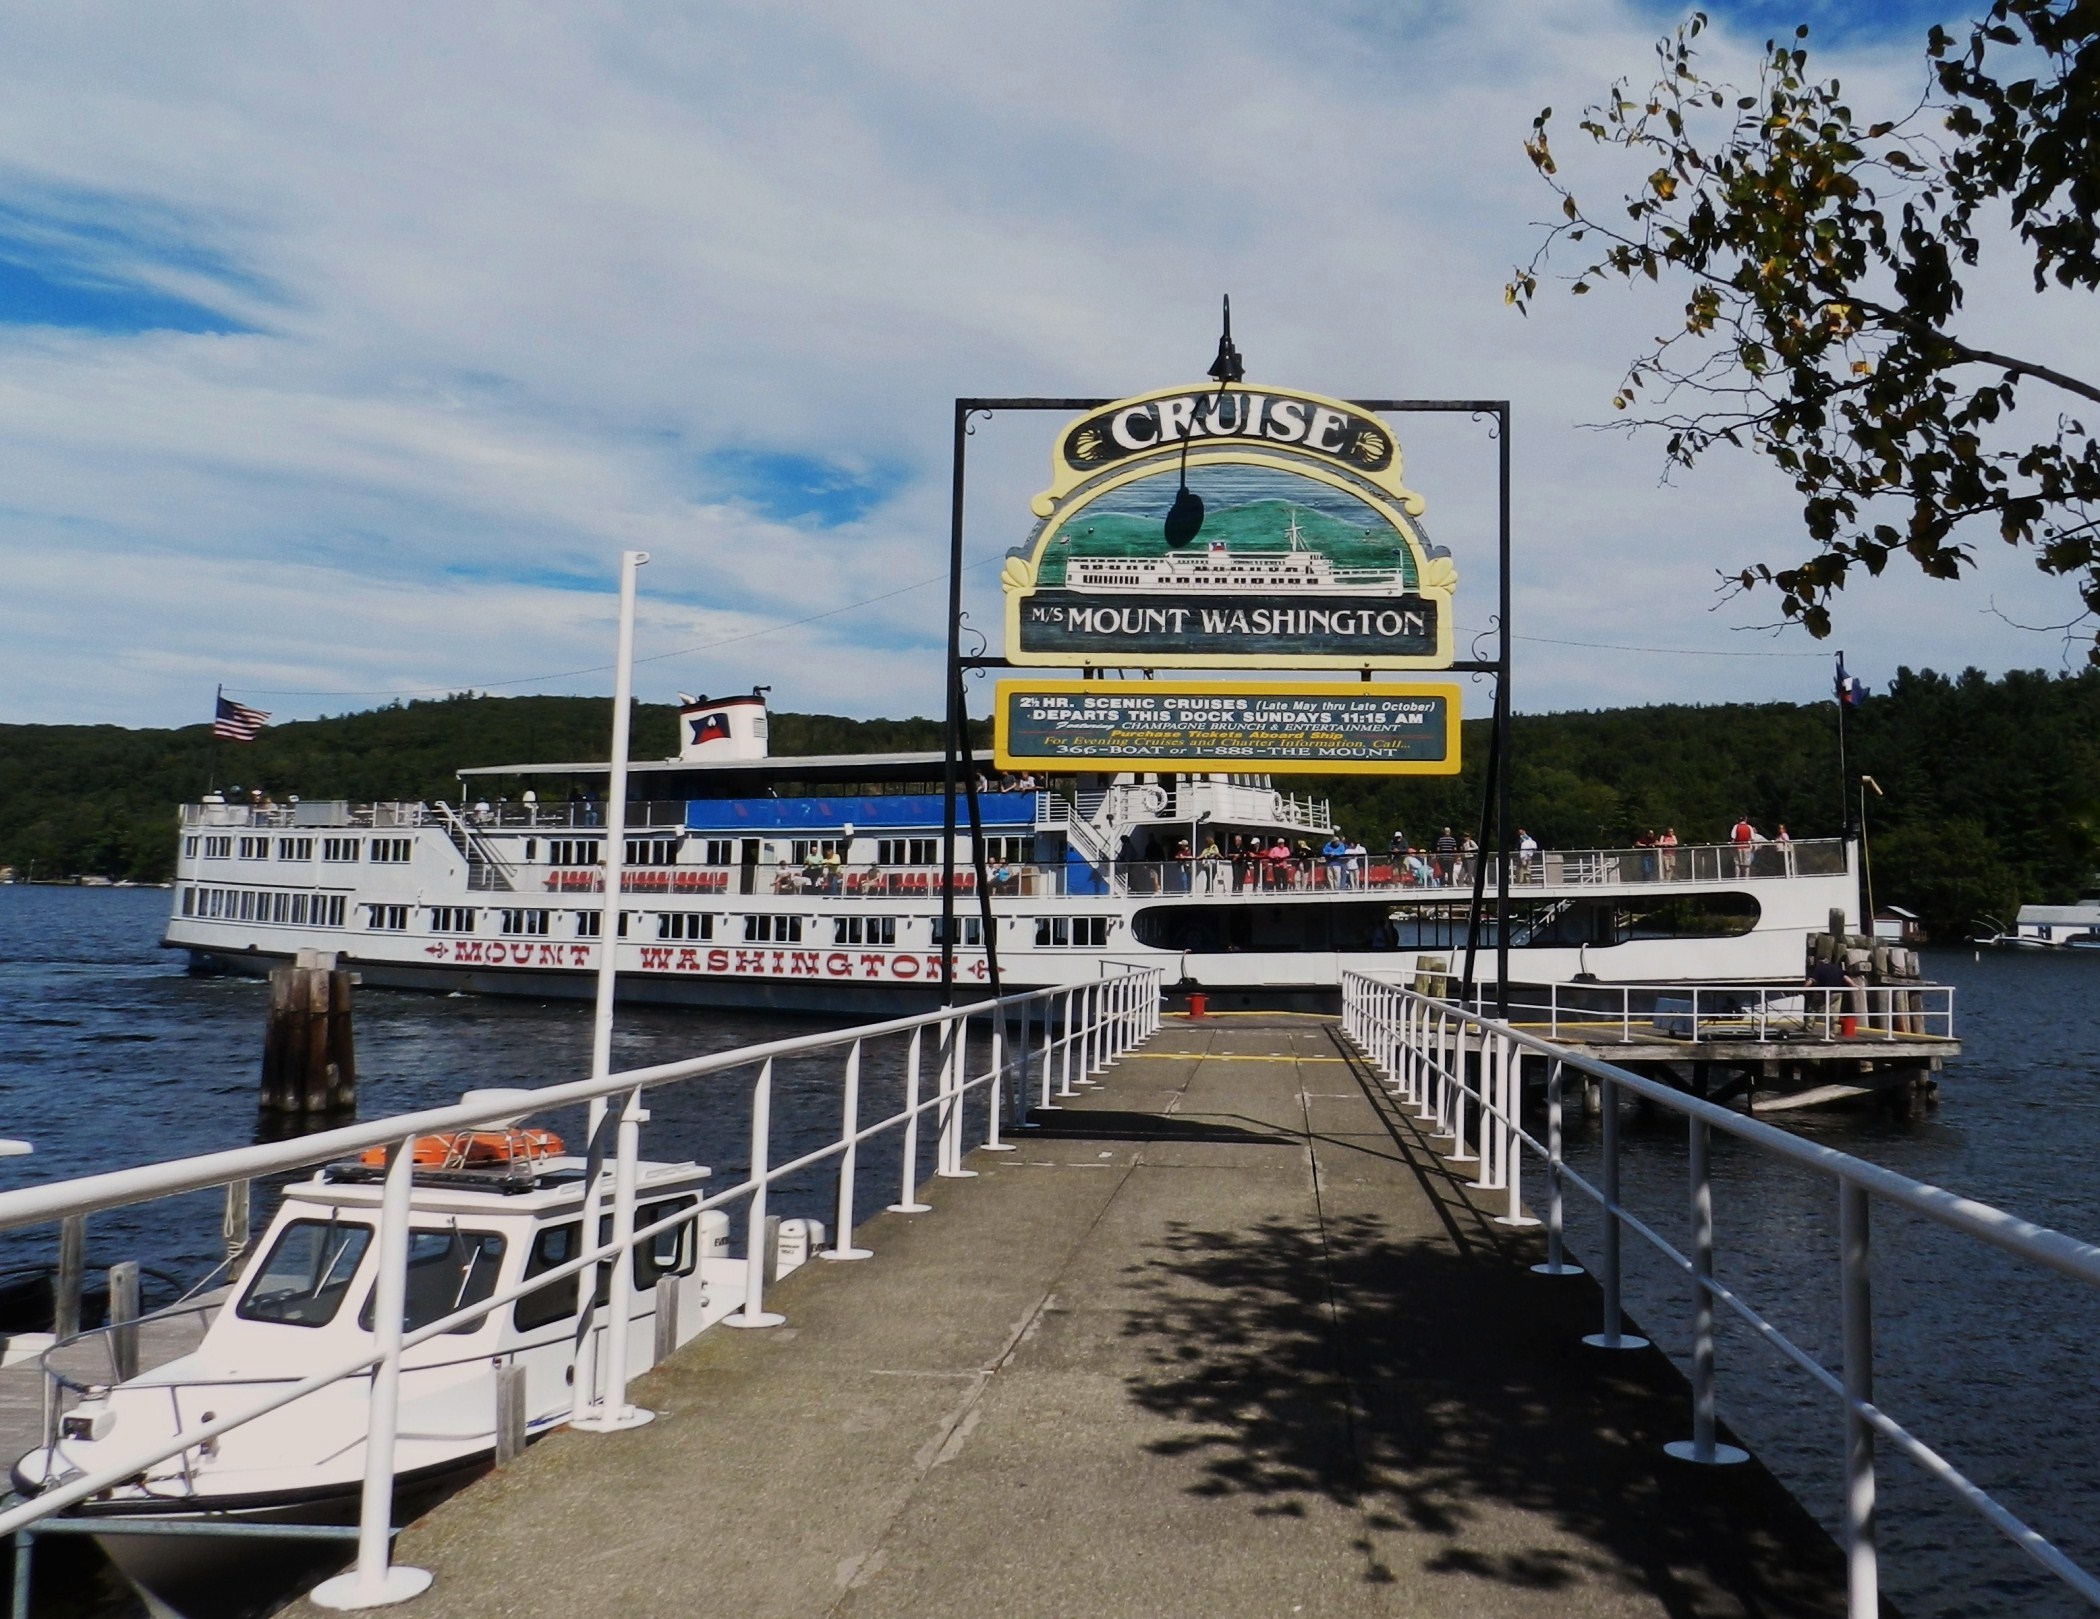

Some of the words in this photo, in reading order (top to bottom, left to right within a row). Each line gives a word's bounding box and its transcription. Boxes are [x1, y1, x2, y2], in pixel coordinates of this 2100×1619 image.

[1111, 393, 1348, 453] CRUISE
[1032, 607, 1063, 622] M/S
[1068, 607, 1190, 635] MOUNT
[1200, 609, 1425, 636] WASHINGTON
[1043, 697, 1075, 708] HR.
[1084, 698, 1155, 709] SCENIC
[1164, 698, 1248, 710] CRUISES
[1256, 700, 1288, 711] (Late
[1293, 701, 1317, 712] May
[1322, 702, 1346, 711] thru
[1350, 702, 1377, 711] Late
[1381, 702, 1436, 713] October)
[1033, 709, 1119, 720] DEPARTS
[1128, 710, 1171, 721] THIS
[1180, 711, 1235, 722] DOCK
[1242, 711, 1332, 723] SUNDAYS
[1341, 713, 1387, 723] 11:15
[1395, 713, 1423, 724] AM
[1121, 721, 1206, 731] CHAMPAGNE
[1210, 722, 1265, 731] BRUNCH
[1284, 723, 1401, 732] ENTERTAINMENT
[1044, 736, 1068, 745] For
[1073, 736, 1128, 747] Evening
[1134, 737, 1184, 746] Cruises
[1189, 738, 1216, 746] and
[1220, 738, 1275, 747] Charter
[1110, 730, 1182, 738] Purchase
[1188, 730, 1243, 738] Tickets
[1249, 731, 1305, 739] Aboard
[1310, 731, 1344, 740] Ship
[1056, 745, 1164, 755] 366-BOAT
[1196, 746, 1311, 756] 1-888-THE
[1318, 748, 1398, 756] MOUNT
[455, 941, 590, 966] MOUNT
[640, 947, 958, 980] WASHINGTON
